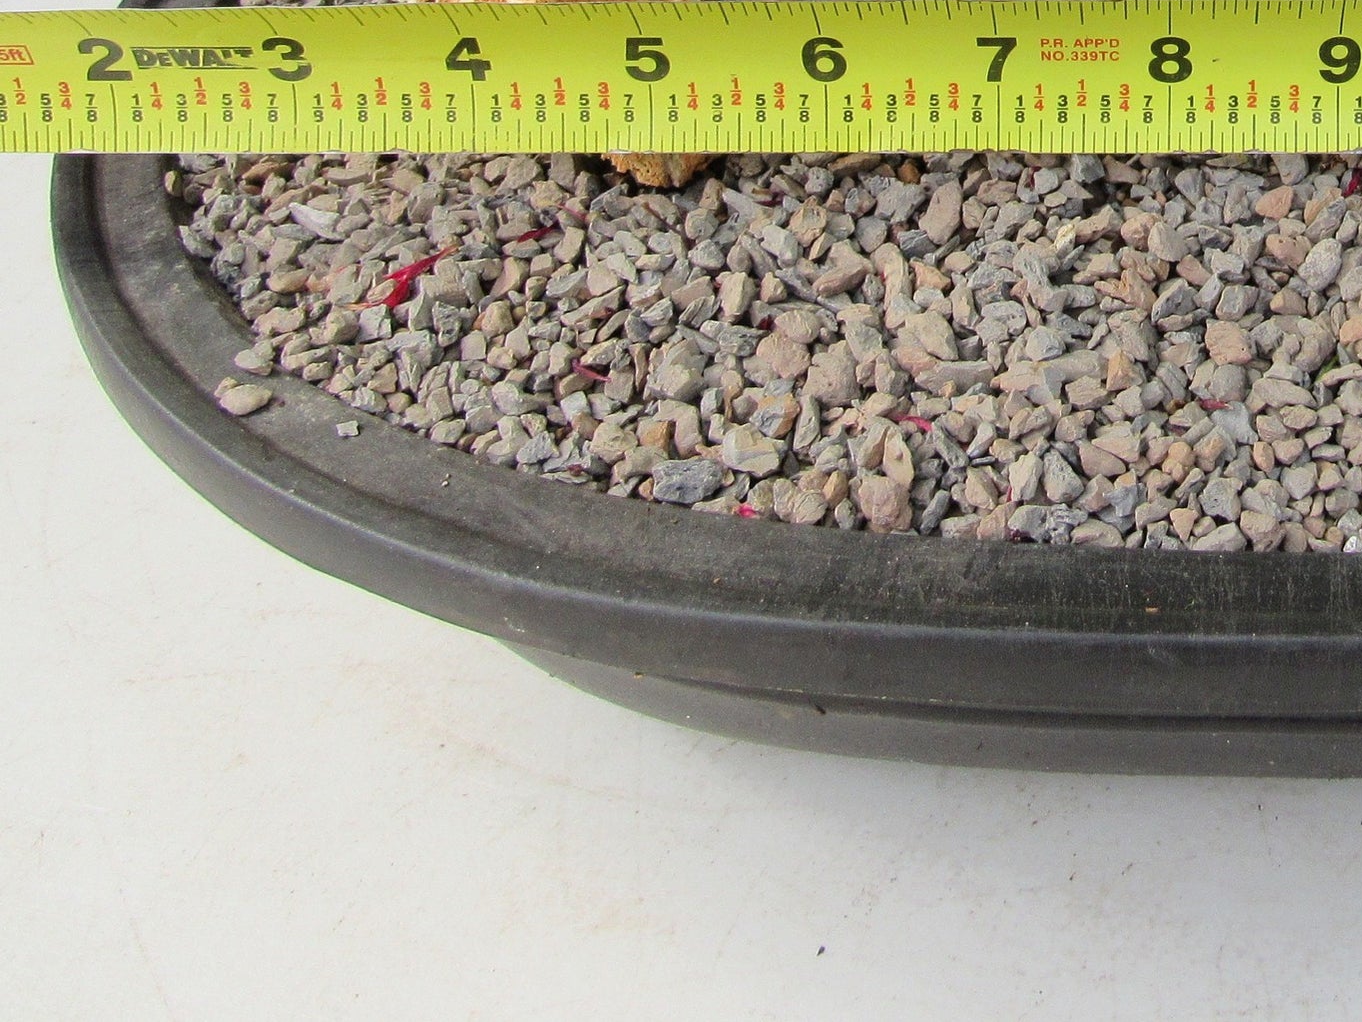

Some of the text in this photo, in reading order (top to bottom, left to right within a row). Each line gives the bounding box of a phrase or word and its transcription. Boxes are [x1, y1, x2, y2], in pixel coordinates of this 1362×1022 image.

[1040, 38, 1120, 49] P.R. APP'D
[78, 38, 133, 81] 2
[262, 37, 312, 81] 3
[445, 37, 492, 81] 4
[625, 37, 671, 82] 5
[801, 36, 848, 82] 6
[976, 37, 1018, 82] 7
[1148, 36, 1193, 83] 8
[1318, 36, 1362, 83] 9
[1040, 50, 1120, 62] NO.339TC
